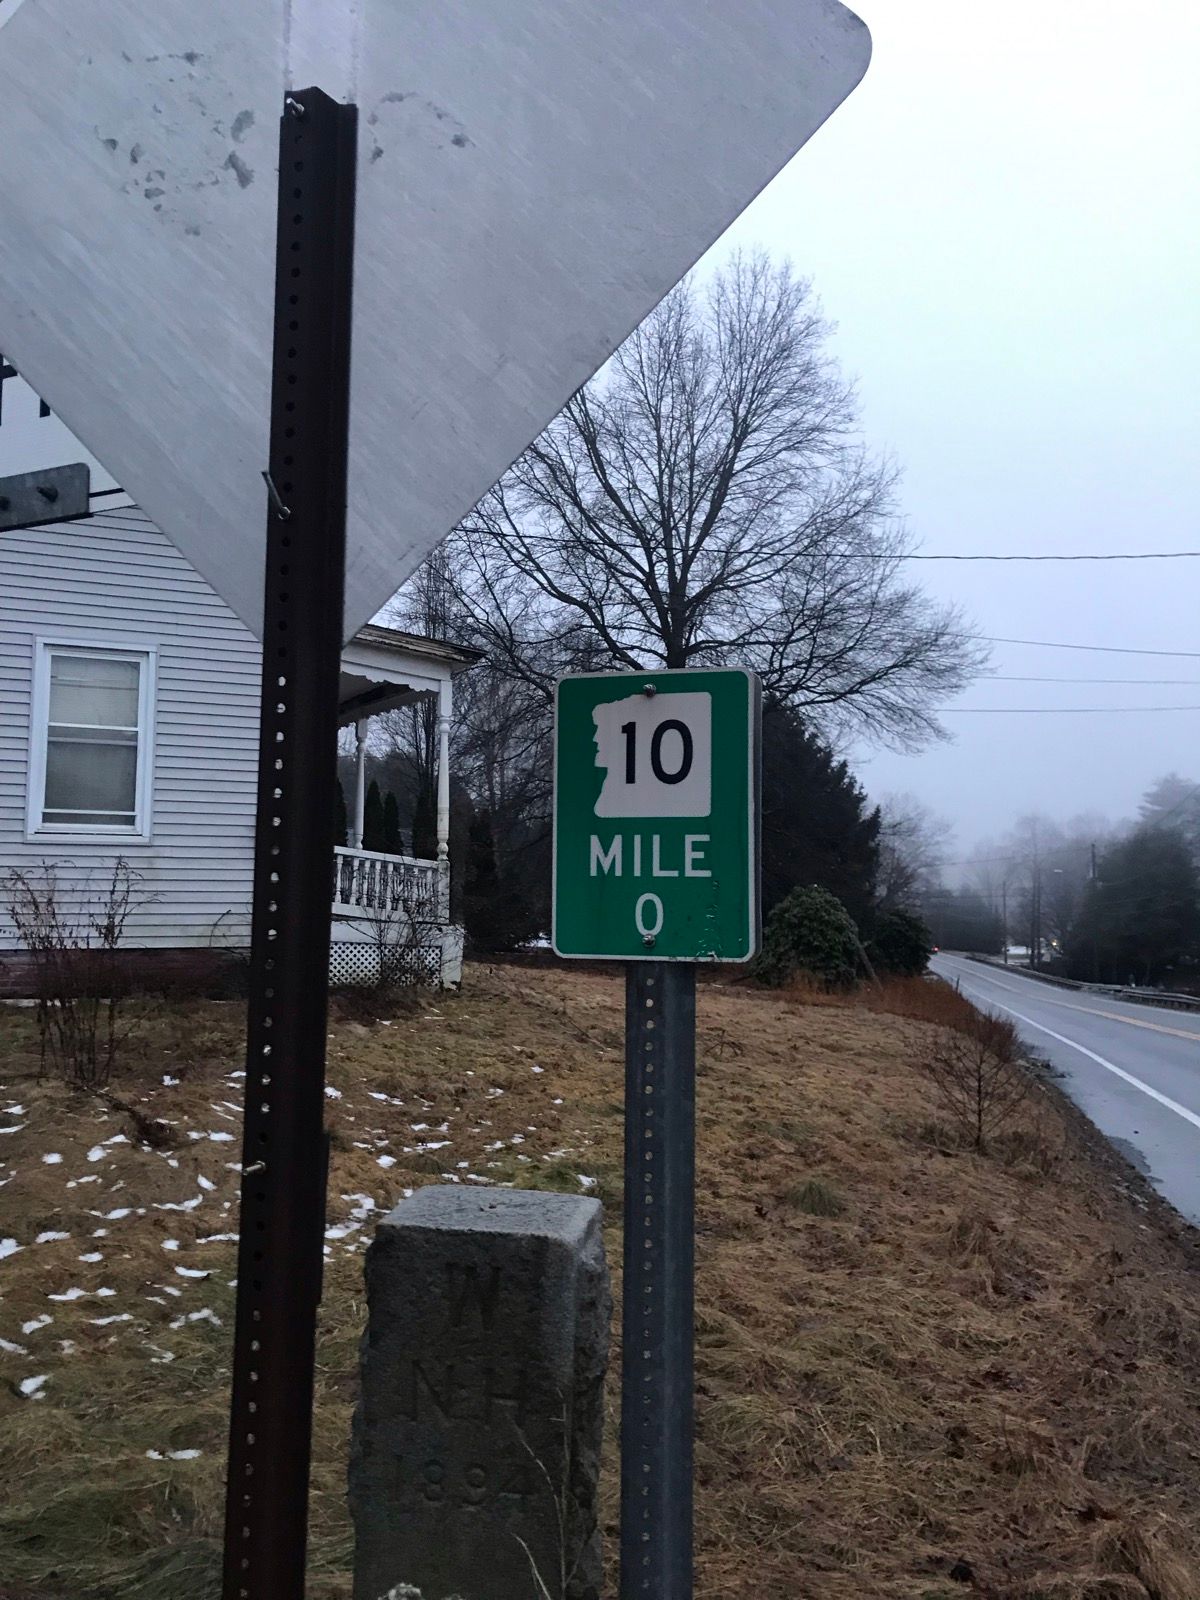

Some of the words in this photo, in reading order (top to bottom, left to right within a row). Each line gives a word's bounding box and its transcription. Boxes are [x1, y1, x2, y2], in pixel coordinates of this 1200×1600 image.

[621, 719, 693, 785] 10
[590, 834, 712, 877] MILE
[635, 893, 664, 939] 0
